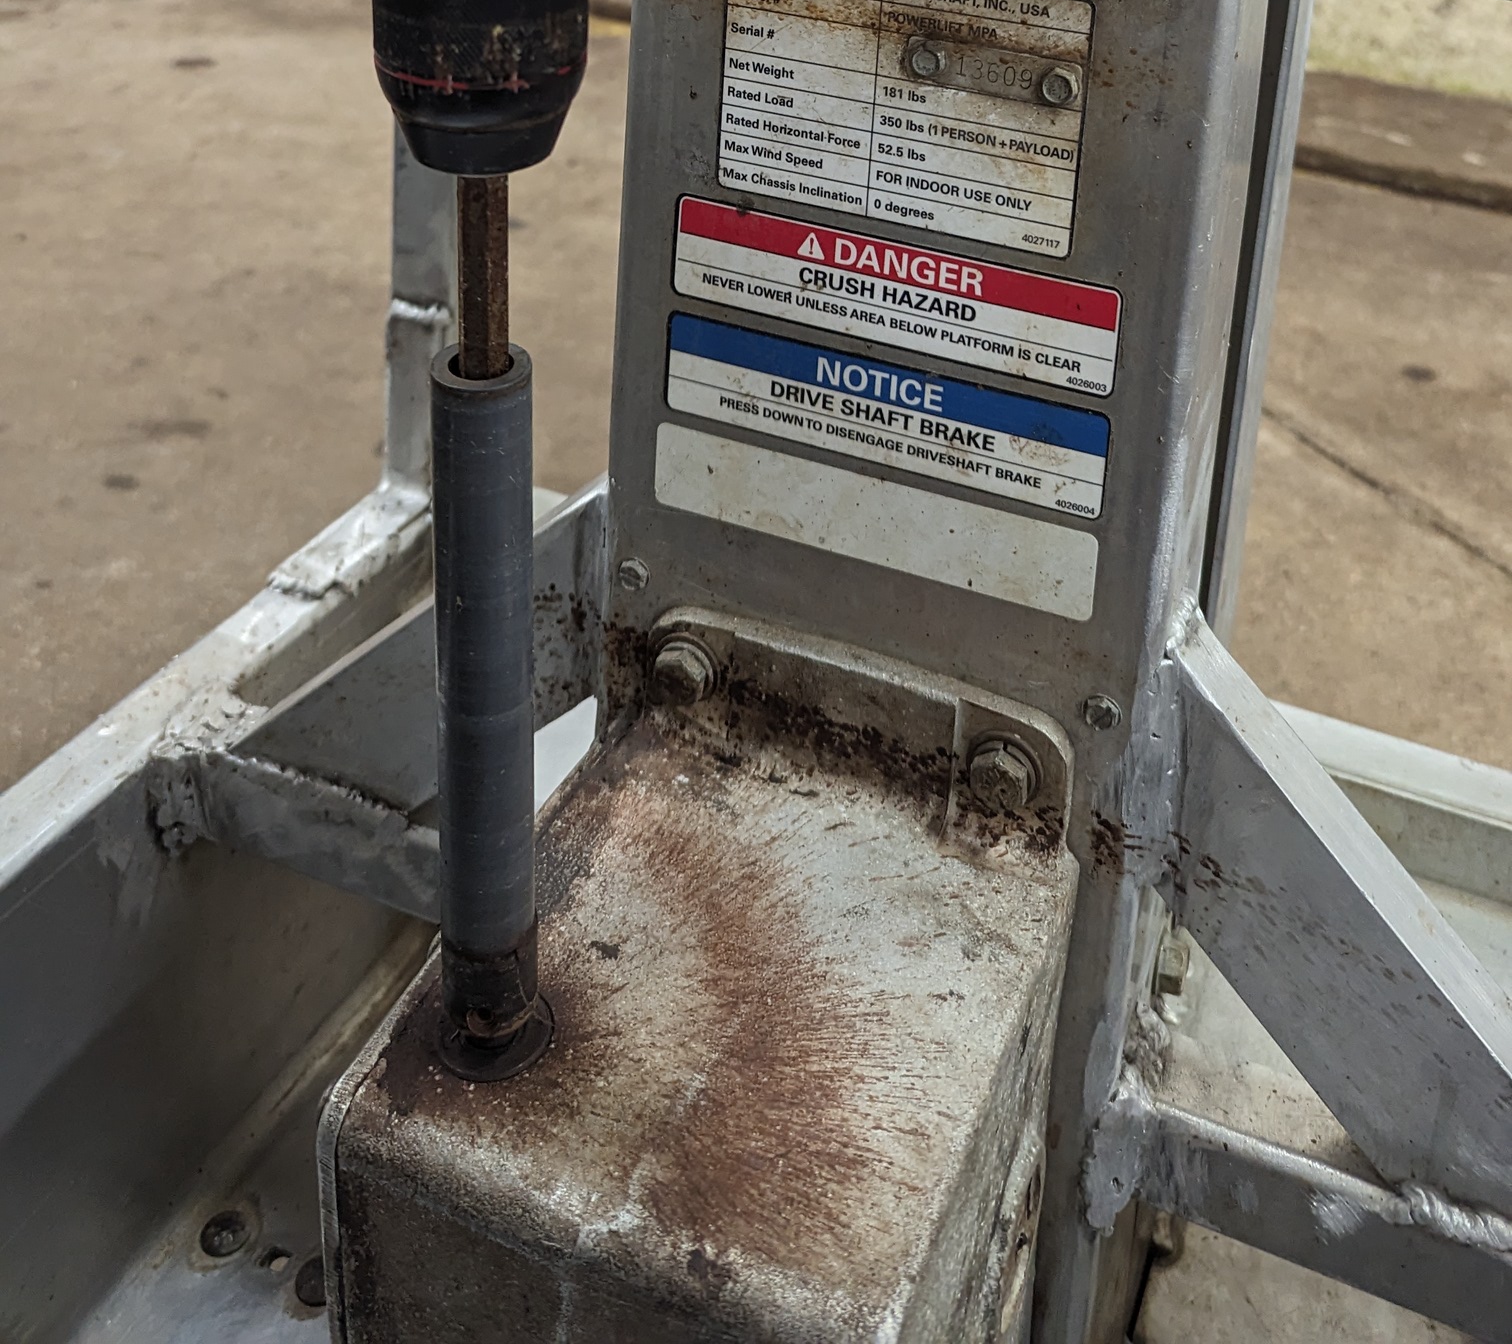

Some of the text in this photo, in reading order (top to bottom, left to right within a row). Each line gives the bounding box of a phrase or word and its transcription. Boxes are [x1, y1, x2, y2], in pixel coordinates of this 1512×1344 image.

[1020, 3, 1050, 18] USA
[731, 22, 775, 39] Serial #
[887, 12, 998, 40] POWERLIFT MPA
[729, 57, 795, 80] Net Weight
[956, 56, 1033, 90] 13609
[727, 86, 794, 108] Rated Load
[882, 86, 927, 104] 181 lbs
[725, 113, 861, 149] Rated Horizontal Force
[879, 115, 902, 129] 350
[906, 119, 925, 133] lbs
[941, 127, 997, 147] PERSON
[1009, 139, 1074, 163] PAYLOAD)
[724, 140, 823, 170] Max Wind Speed
[878, 143, 926, 162] 52.5 lbs
[722, 167, 862, 206] Max Chassis Inclination
[876, 170, 1032, 211] FOR INDOOR USE ONLY
[873, 198, 935, 221] 0 degrees
[1021, 233, 1061, 249] 4027117
[834, 237, 983, 297] DANGER
[798, 266, 977, 323] CRUSH HAZARD
[702, 273, 1081, 373] NEVER LOWER UNLESS AREA BELOW PLATFORM IS CLEAR
[816, 356, 944, 413] NOTICE
[1065, 375, 1108, 393] 4026003
[769, 379, 996, 453] DRIVE SHAFT BRAKE
[719, 396, 1042, 489] PRESS DOWN TO DISENGAGE DRIVESHAFT BRAKE
[1054, 498, 1095, 517] 4026004
